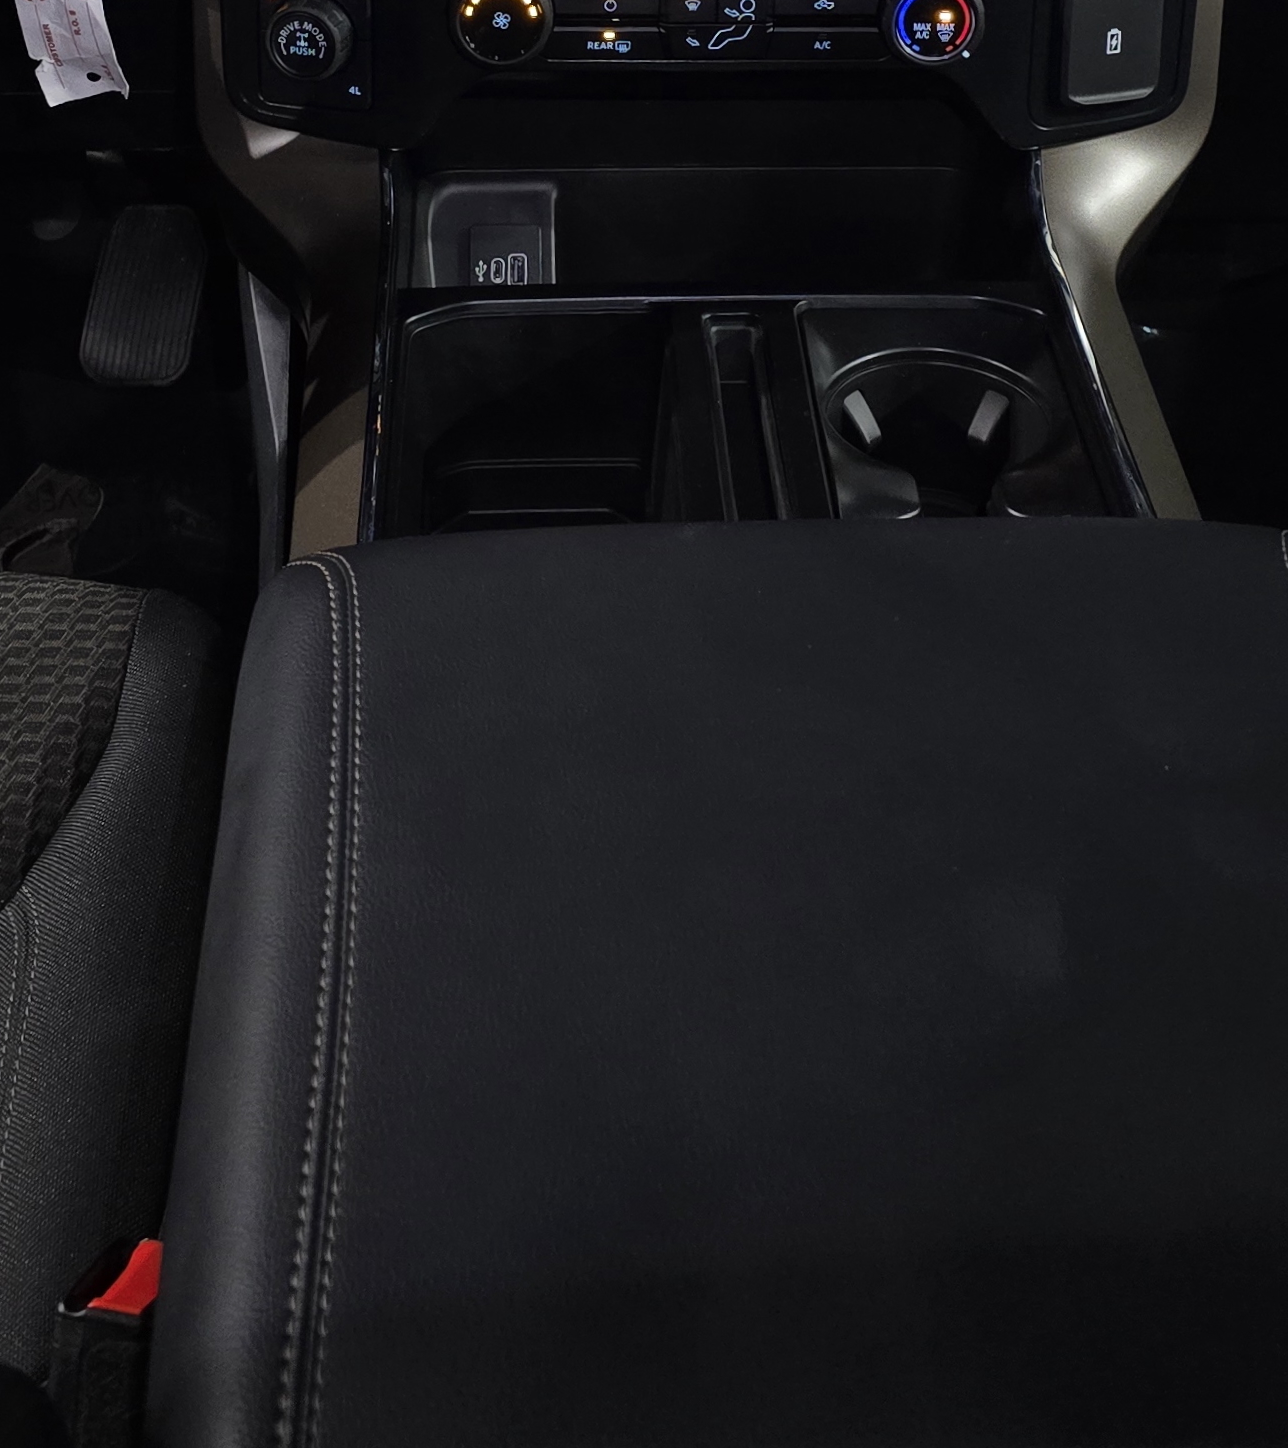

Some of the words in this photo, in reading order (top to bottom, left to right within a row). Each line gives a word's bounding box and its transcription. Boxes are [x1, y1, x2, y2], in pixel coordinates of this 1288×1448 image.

[71, 16, 82, 36] R.O.
[913, 22, 932, 31] MAX
[936, 23, 955, 32] MAX
[277, 20, 302, 44] DRIVE
[302, 21, 327, 48] MODE
[915, 31, 930, 39] A/C
[42, 23, 64, 68] CUSTOMER
[587, 41, 614, 50] REAR
[814, 41, 831, 50] A/C
[290, 46, 316, 56] PUSH
[348, 86, 362, 96] 4L
